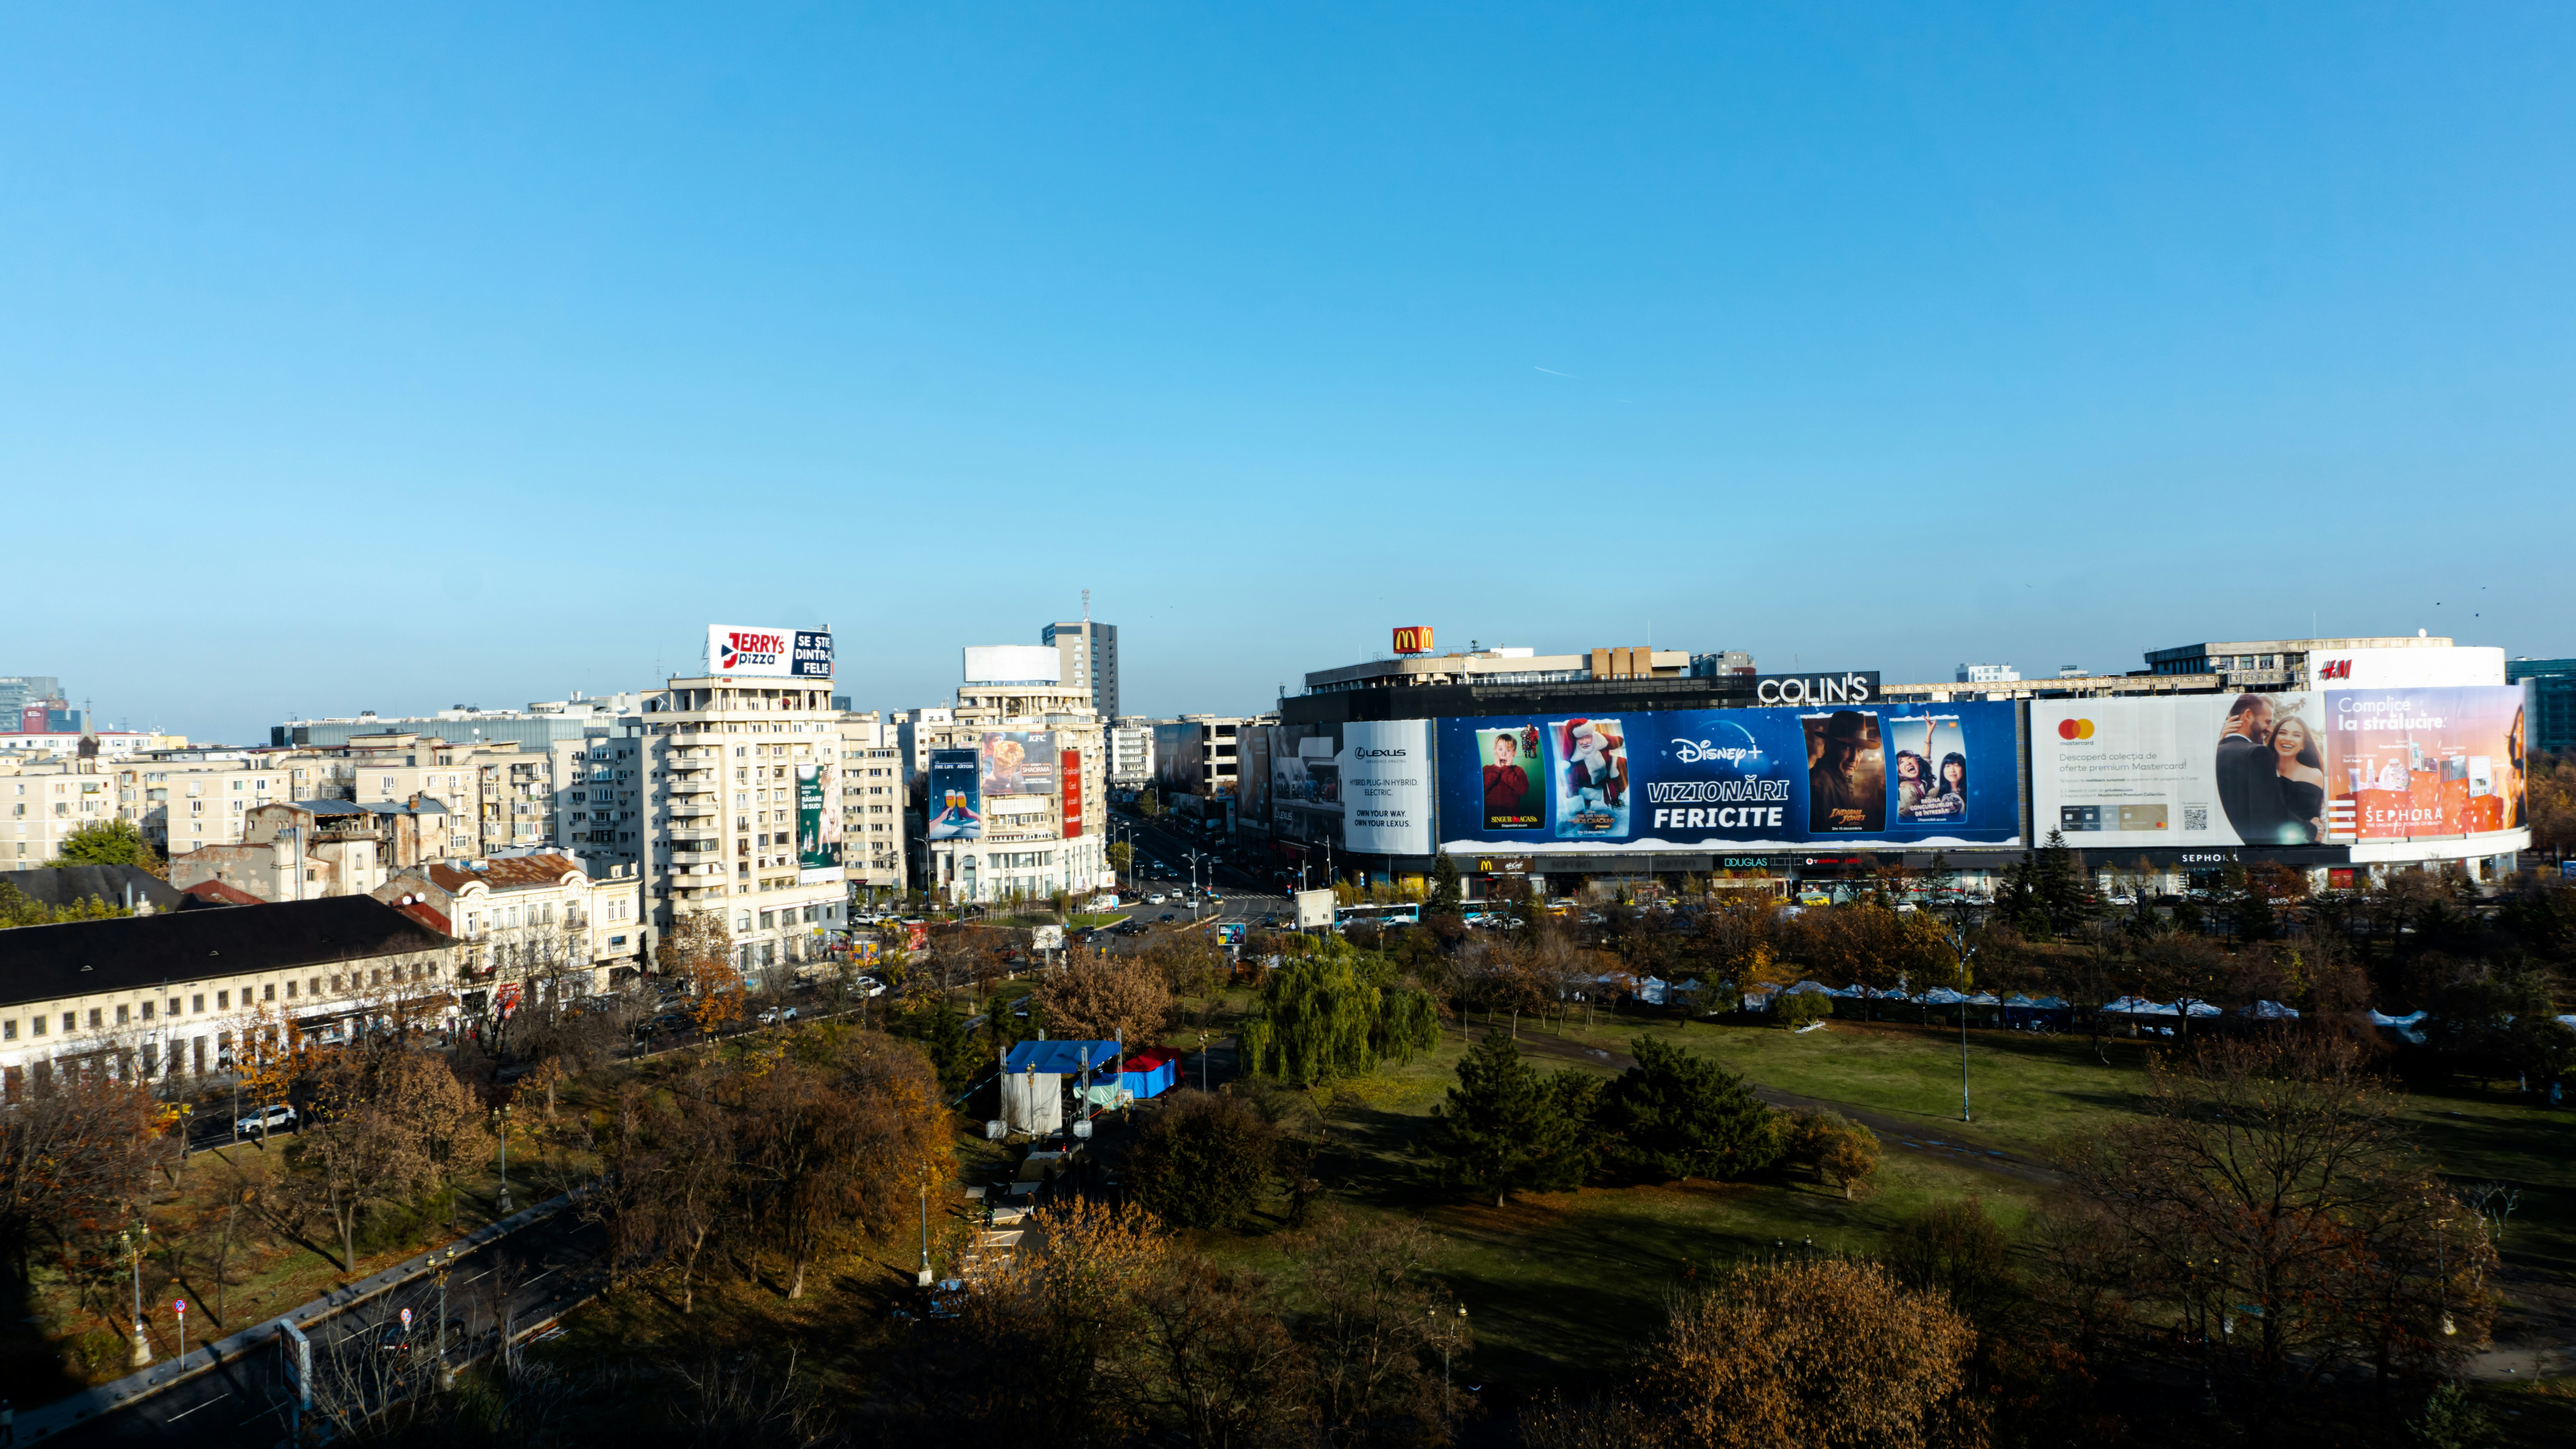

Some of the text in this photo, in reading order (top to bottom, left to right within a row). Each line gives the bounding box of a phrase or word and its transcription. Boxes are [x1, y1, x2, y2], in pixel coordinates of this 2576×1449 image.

[798, 636, 811, 646] SE
[738, 653, 775, 665] pizza
[796, 649, 831, 661] DINTR-O
[804, 663, 828, 674] FELIE
[2321, 659, 2352, 680] H&M
[1757, 672, 1868, 703] COLIN'S
[2338, 695, 2411, 716] Complice
[2339, 714, 2357, 731] la
[2059, 753, 2106, 762] Descoperă
[2089, 764, 2129, 773] premium
[2132, 758, 2187, 770] Mastercard!
[1647, 774, 1789, 803] VIZIONĂRI
[1910, 801, 1953, 811] CONCURSURILOR
[1923, 808, 1950, 816] ÎNTREBĂRI
[1067, 814, 1079, 823] aircash
[1654, 806, 1783, 828] FERICITE
[1829, 808, 1862, 818] INDIANA
[2366, 807, 2443, 822] SEPHORA
[1838, 815, 1866, 824] JONES
[1724, 858, 1768, 867] DOUGLAS
